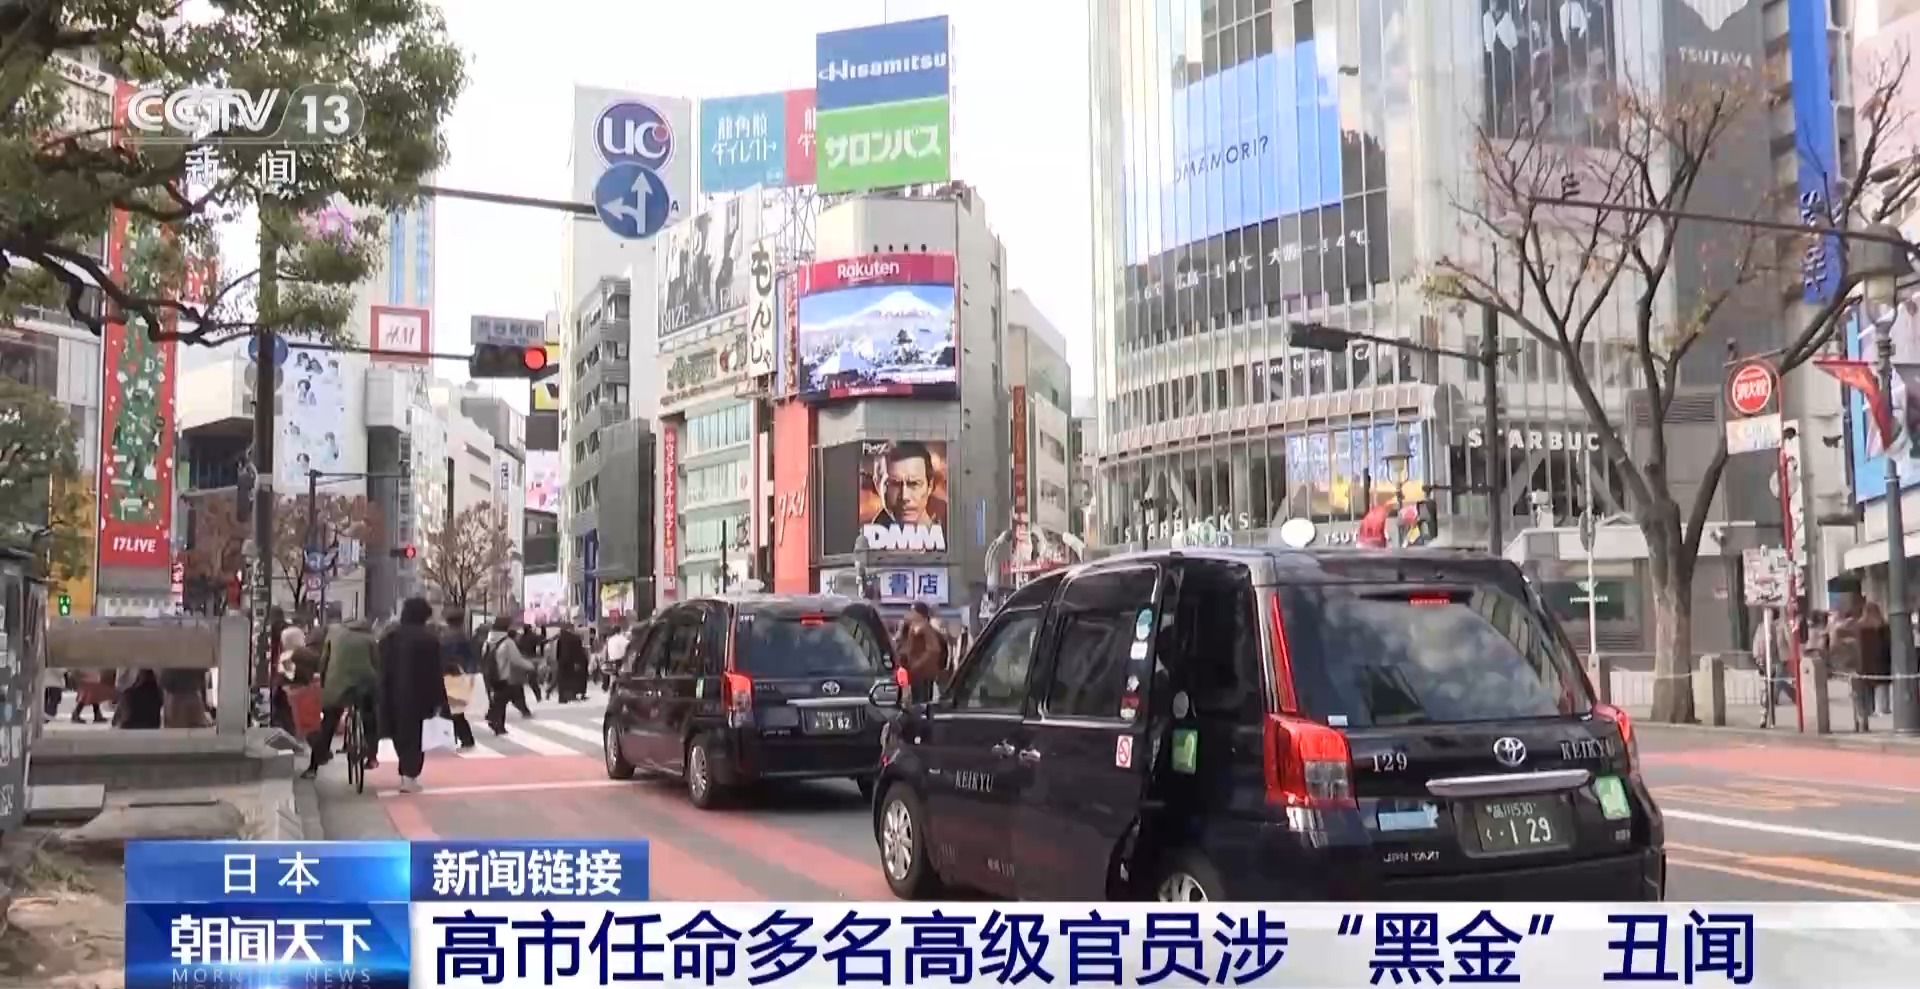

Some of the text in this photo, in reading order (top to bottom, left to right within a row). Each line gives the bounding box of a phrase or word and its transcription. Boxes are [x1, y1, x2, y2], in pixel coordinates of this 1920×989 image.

[818, 51, 948, 81] Hisamitsu
[1679, 46, 1753, 70] TSUTAYA
[602, 115, 669, 158] UC
[824, 123, 941, 169] サロンパス
[837, 262, 900, 280] Rakuten
[750, 239, 772, 370] もんじゃ
[113, 536, 157, 553] 17LIVE
[864, 522, 946, 551] DMM
[1373, 751, 1408, 773] 129
[955, 769, 993, 793] KEIKYU
